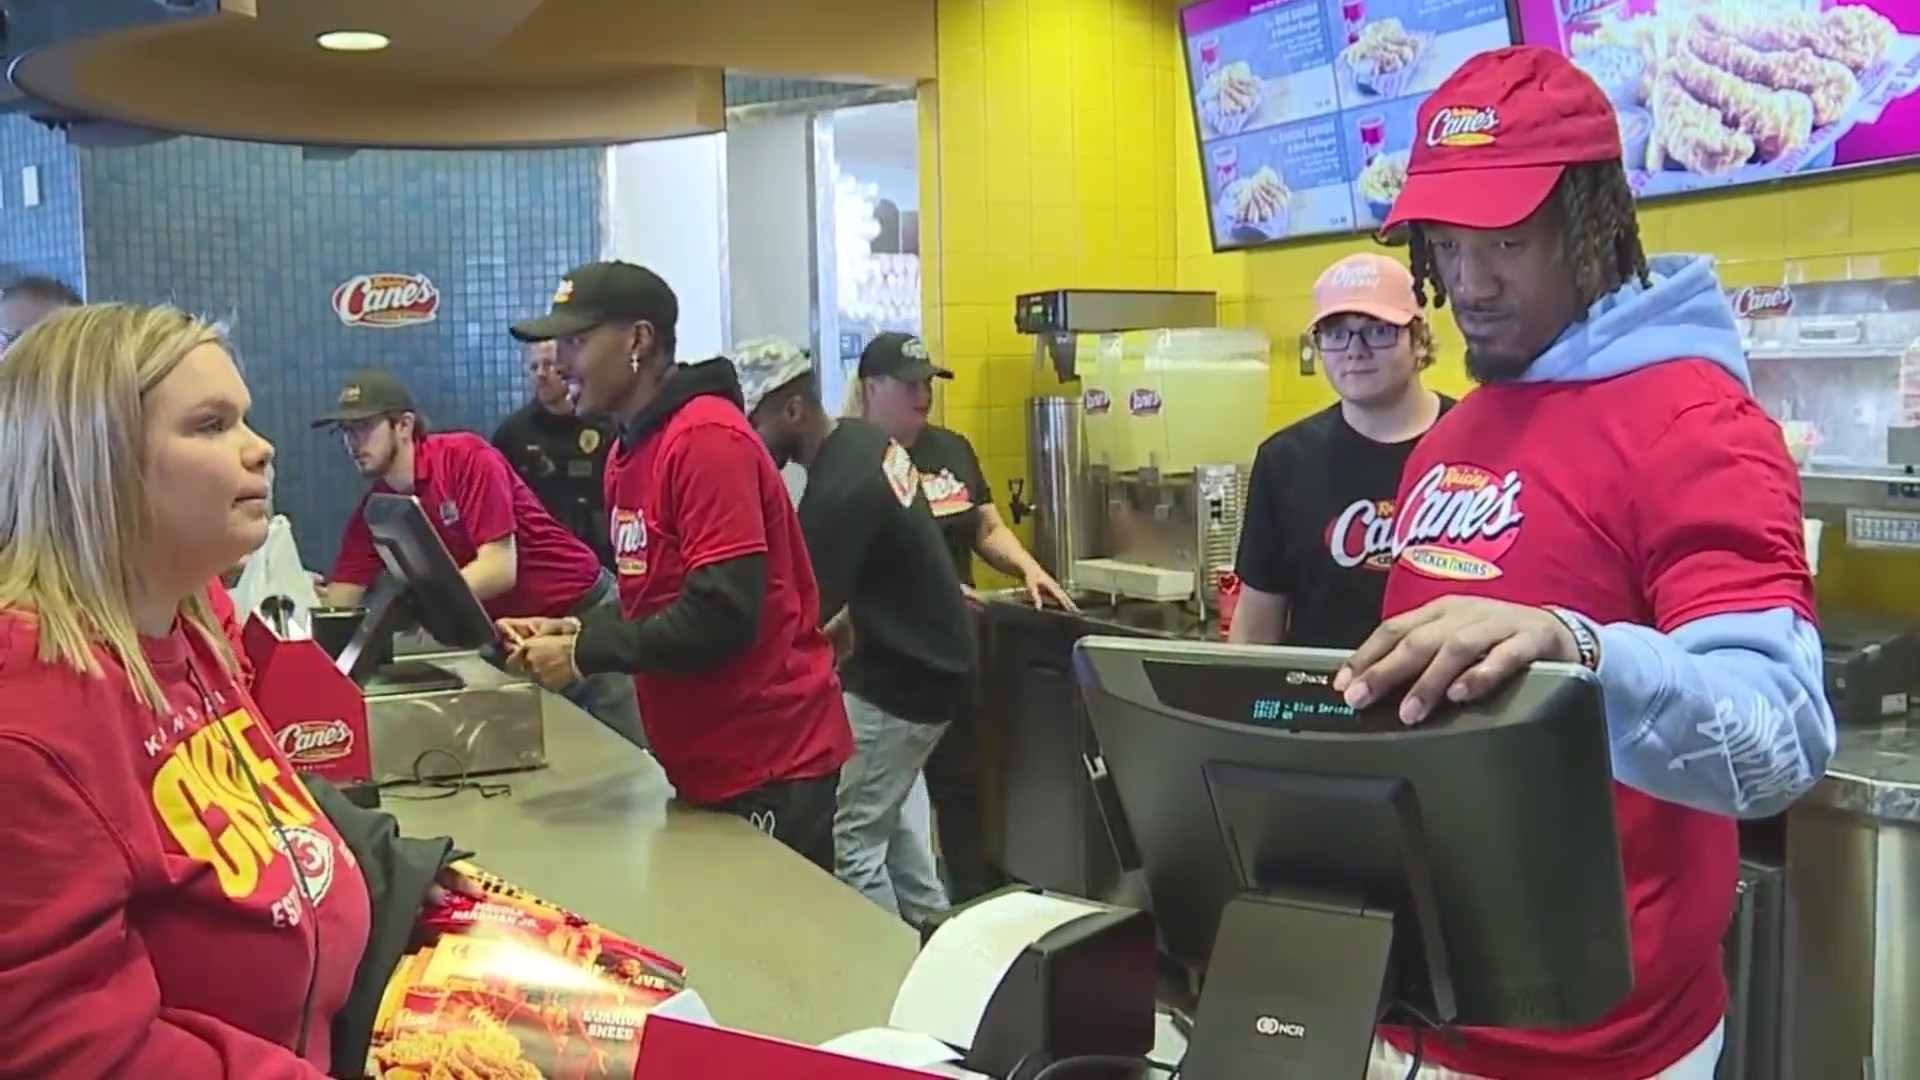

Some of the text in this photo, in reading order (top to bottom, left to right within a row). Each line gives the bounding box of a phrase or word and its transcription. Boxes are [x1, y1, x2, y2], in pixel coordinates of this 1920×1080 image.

[1426, 105, 1499, 147] Cane's
[338, 274, 432, 321] Cane's
[1736, 284, 1792, 315] Cane's
[1393, 463, 1525, 558] Cane's
[278, 719, 349, 759] Cane's
[1280, 1021, 1306, 1038] NCR
